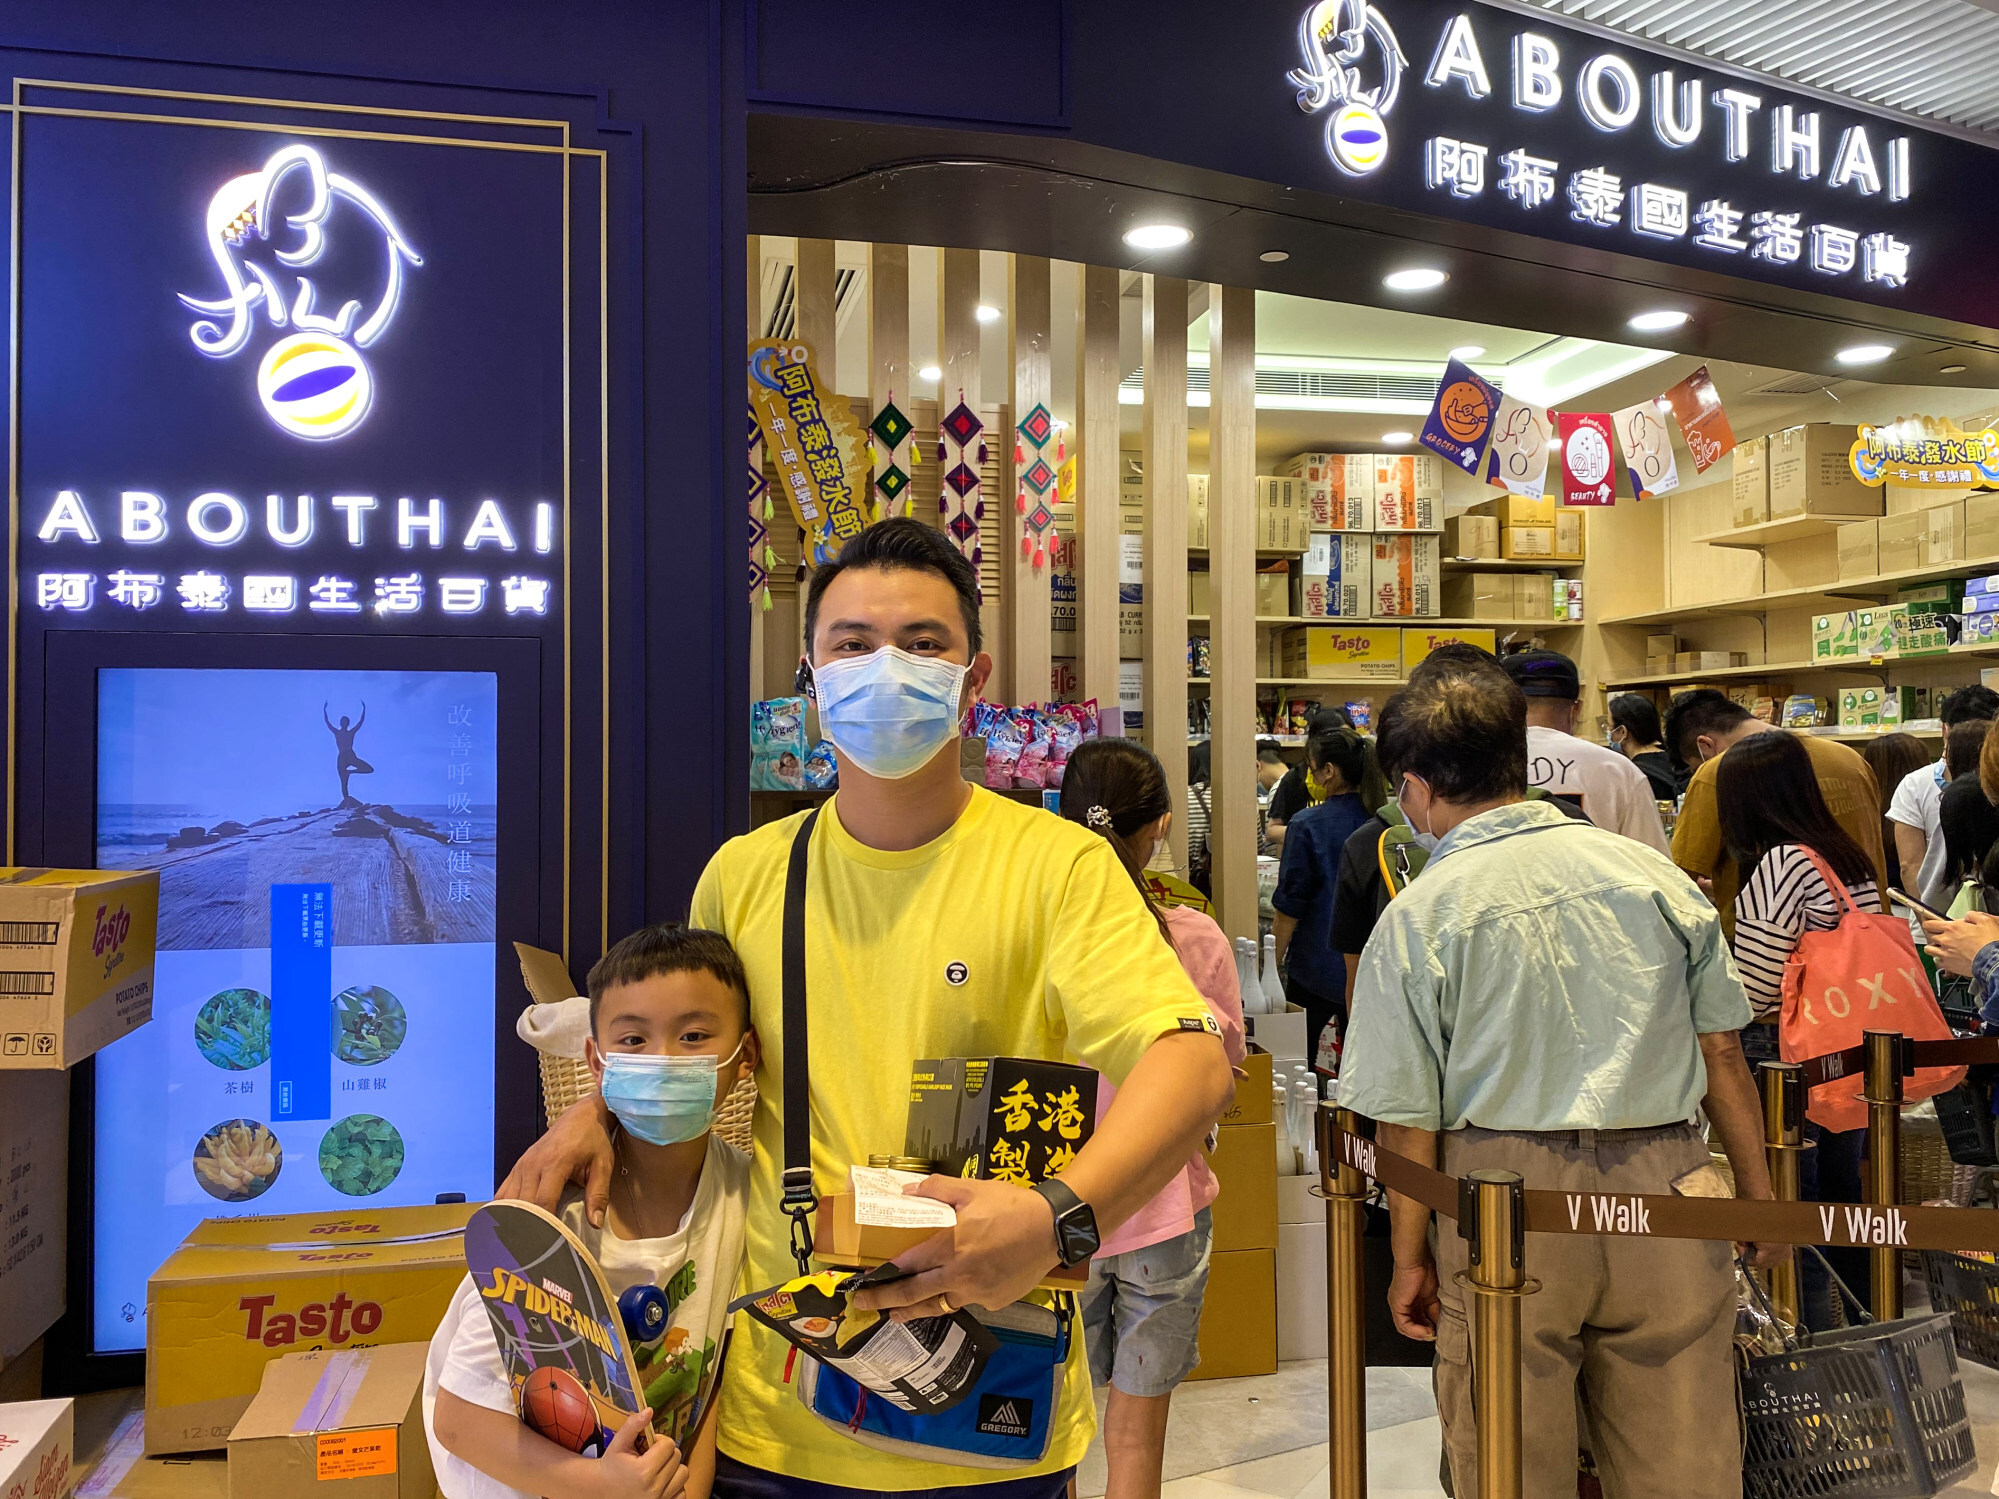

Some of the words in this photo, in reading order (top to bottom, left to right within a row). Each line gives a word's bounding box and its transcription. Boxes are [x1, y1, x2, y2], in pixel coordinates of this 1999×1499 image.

[1427, 14, 1912, 201] ABOUTHAI
[1426, 136, 1913, 287] 阿布泰國生活百貨
[776, 363, 863, 540] 阿布泰潑水節
[1425, 432, 1462, 455] GROCERY
[1868, 433, 1987, 465] 阿布泰潑水節
[1570, 490, 1596, 502] BEAUTY
[37, 490, 554, 553] ABOUTHAI
[36, 570, 549, 614] 阿布泰國生活百貨
[1908, 613, 1936, 634] 極速
[1331, 634, 1371, 652] Tasto
[1427, 635, 1466, 650] Tast
[1896, 631, 1946, 650] 趕走酸痛
[446, 703, 473, 904] 改善呼吸道健康
[92, 903, 131, 958] Tasto
[115, 986, 134, 1006] POTATO
[134, 981, 149, 998] CHIPS
[1821, 1056, 1827, 1081] V
[1827, 1052, 1844, 1079] Walk
[224, 1080, 254, 1095] 茶樹
[342, 1077, 387, 1092] 山雞椒
[993, 1078, 1086, 1140] 香港
[1343, 1132, 1351, 1164] V
[1353, 1136, 1377, 1178] Walk
[308, 1223, 382, 1235] Tasto
[1566, 1194, 1582, 1231] V
[1590, 1195, 1651, 1234] Walk
[1818, 1205, 1835, 1242] V
[1844, 1206, 1909, 1245] Walk
[298, 1252, 374, 1261] Tasto
[542, 1277, 573, 1304] MARVEL
[239, 1292, 384, 1348] Tasto
[481, 1266, 618, 1362] SPIDER-MAN
[981, 1422, 1027, 1435] GREGORY
